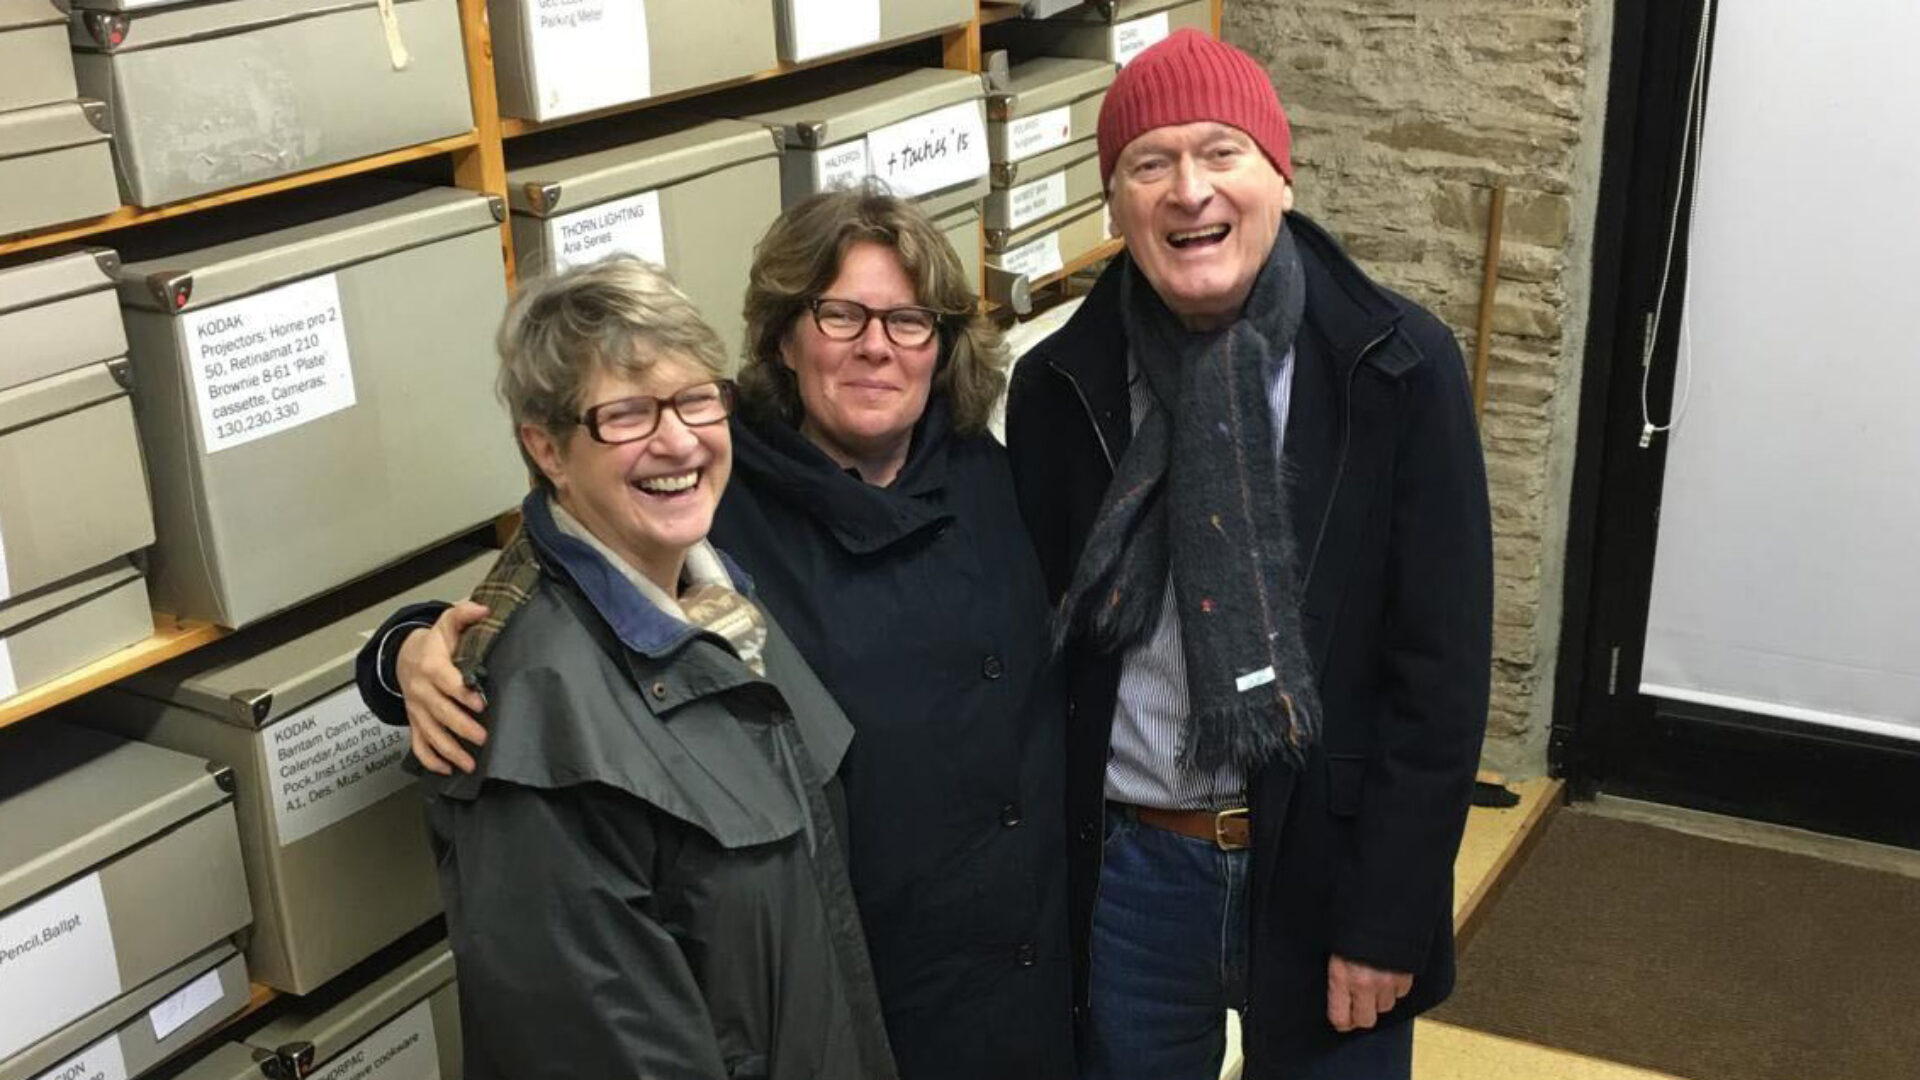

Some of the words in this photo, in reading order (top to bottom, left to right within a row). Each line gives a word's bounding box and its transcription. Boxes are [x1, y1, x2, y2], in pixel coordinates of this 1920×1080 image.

[541, 13, 577, 28] Parking
[561, 219, 598, 239] THORN
[599, 205, 645, 229] LIGHTING
[584, 231, 613, 249] Series
[197, 314, 244, 338] KODAK
[201, 331, 267, 358] Projectors:
[269, 320, 305, 338] Home
[307, 313, 326, 330] pro
[327, 306, 337, 322] 2
[230, 344, 293, 371] Retinamat
[295, 334, 320, 353] 210
[208, 375, 260, 399] Brownie
[217, 402, 300, 439] 130,230,330
[275, 715, 317, 743] KODAK
[278, 735, 323, 761] Bantam
[373, 1033, 419, 1068] cookware
